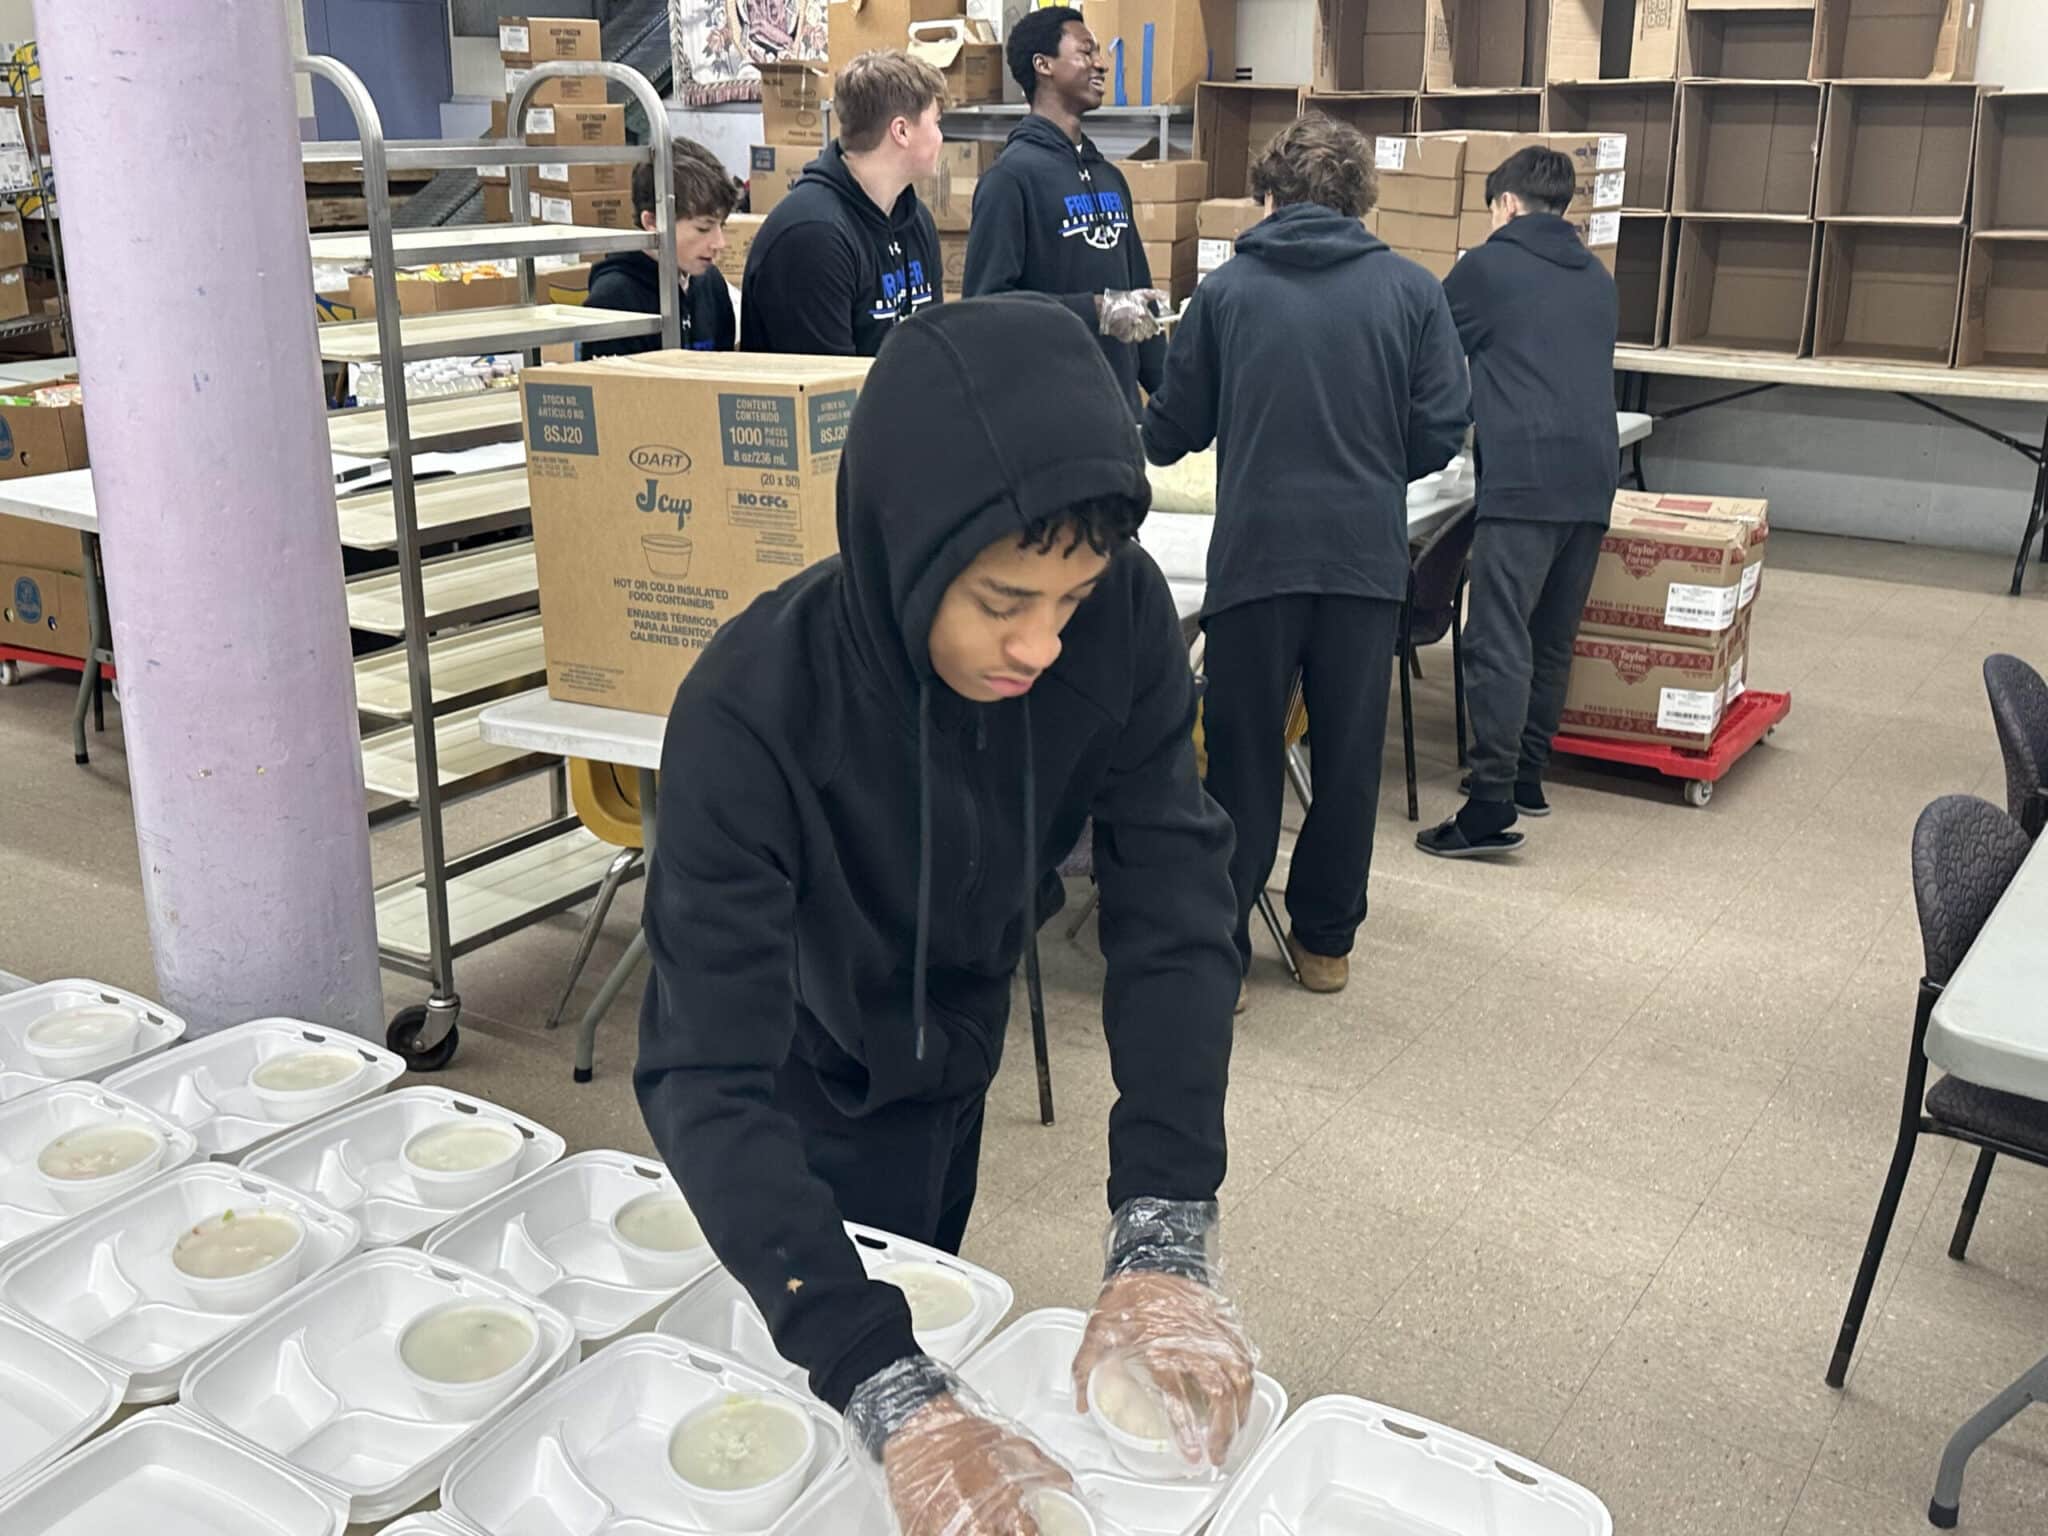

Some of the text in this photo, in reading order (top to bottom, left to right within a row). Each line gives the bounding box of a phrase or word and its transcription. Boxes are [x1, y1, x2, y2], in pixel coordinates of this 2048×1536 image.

[542, 394, 565, 406] STOCK
[736, 399, 777, 411] CONTENTS
[736, 411, 779, 423] CONTENIDO
[543, 424, 583, 444] 8SJ20
[729, 427, 762, 446] 1000
[637, 451, 683, 468] DART
[733, 451, 740, 462] 8
[741, 451, 771, 464] oz/236
[761, 473, 776, 487] (20
[785, 474, 801, 488] 50)
[737, 493, 788, 508] NO CFCs
[1628, 542, 1657, 556] Taylor
[1626, 554, 1655, 566] Farms
[613, 577, 729, 600] HOT OR COLD INSULATED
[628, 591, 715, 610] FOOD CONTAINERS
[627, 607, 668, 622] ENVASES
[634, 620, 658, 632] PARA
[630, 630, 681, 647] CALIENTES
[682, 639, 689, 648] O
[1620, 650, 1648, 662] Taylor
[1617, 660, 1647, 672] Farms
